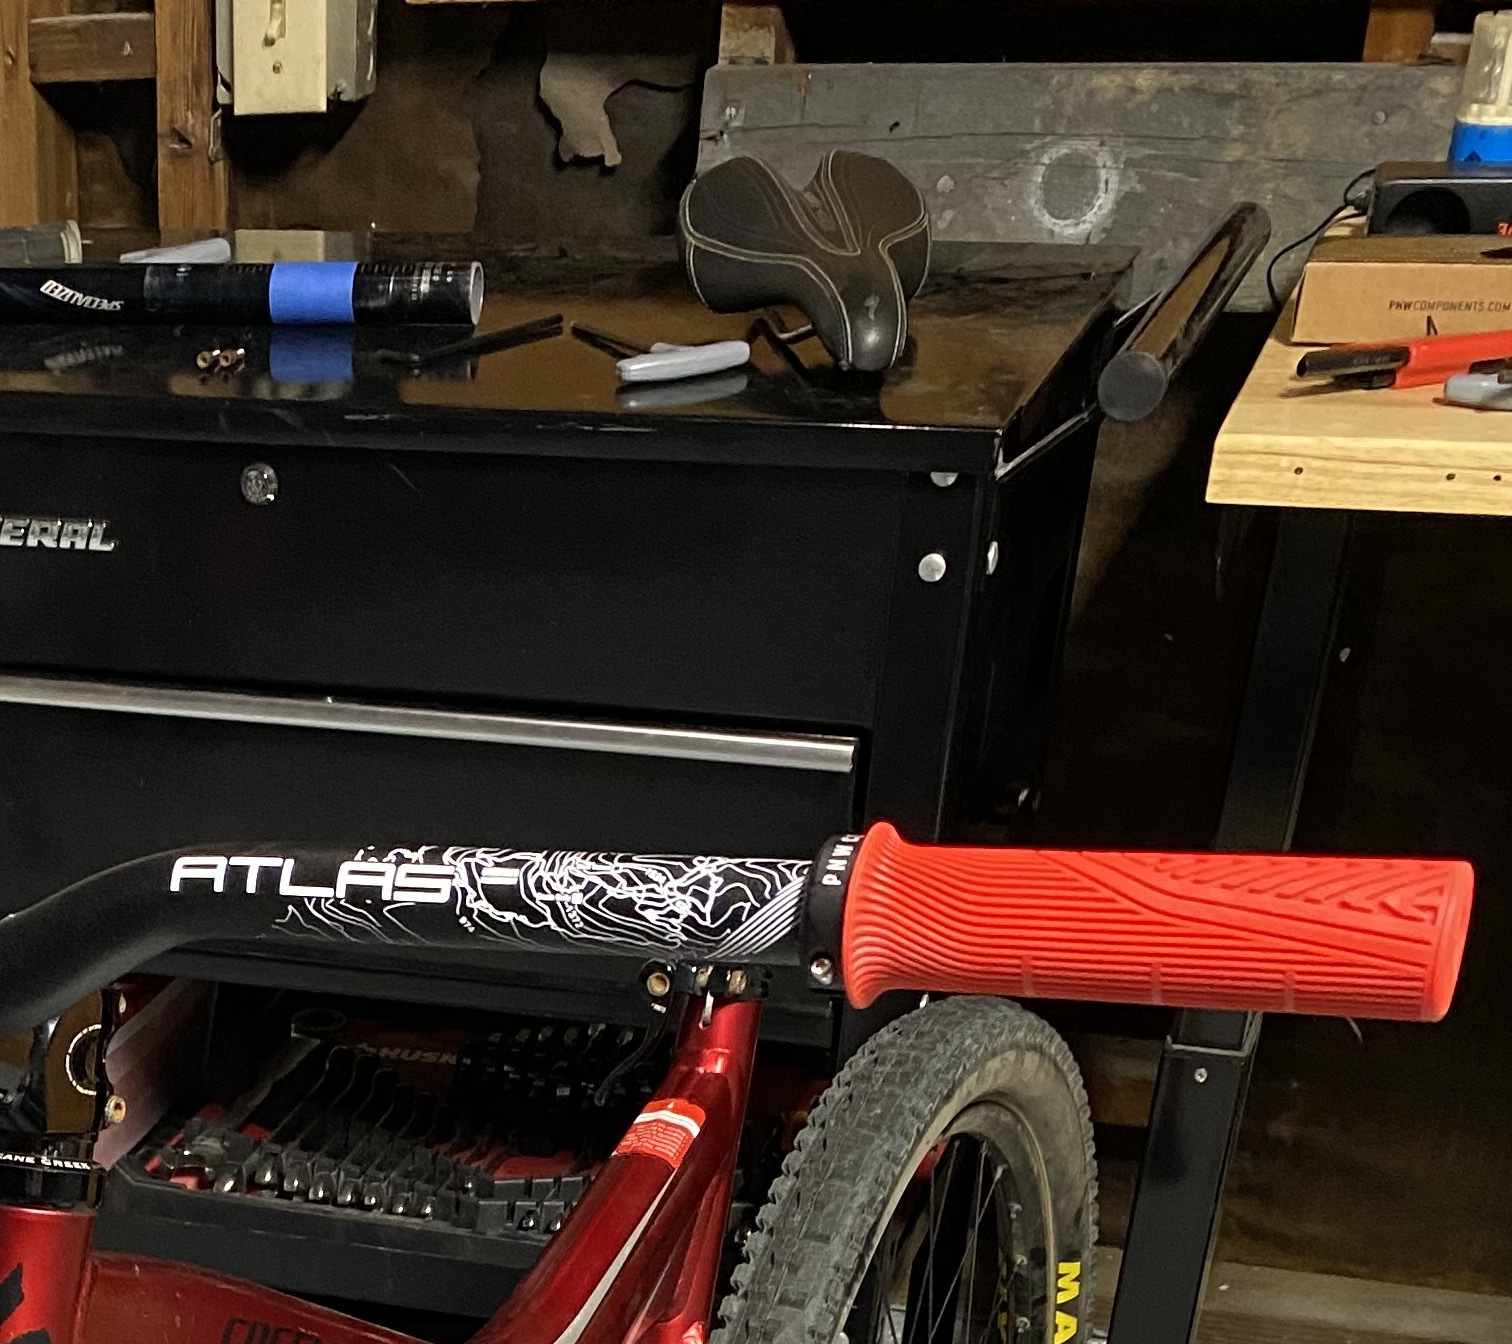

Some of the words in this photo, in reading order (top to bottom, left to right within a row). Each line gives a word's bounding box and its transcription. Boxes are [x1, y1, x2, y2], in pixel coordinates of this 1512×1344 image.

[39, 279, 125, 312] SPECIALIZED
[169, 855, 457, 904] ATLAS
[379, 1050, 457, 1066] HUSK
